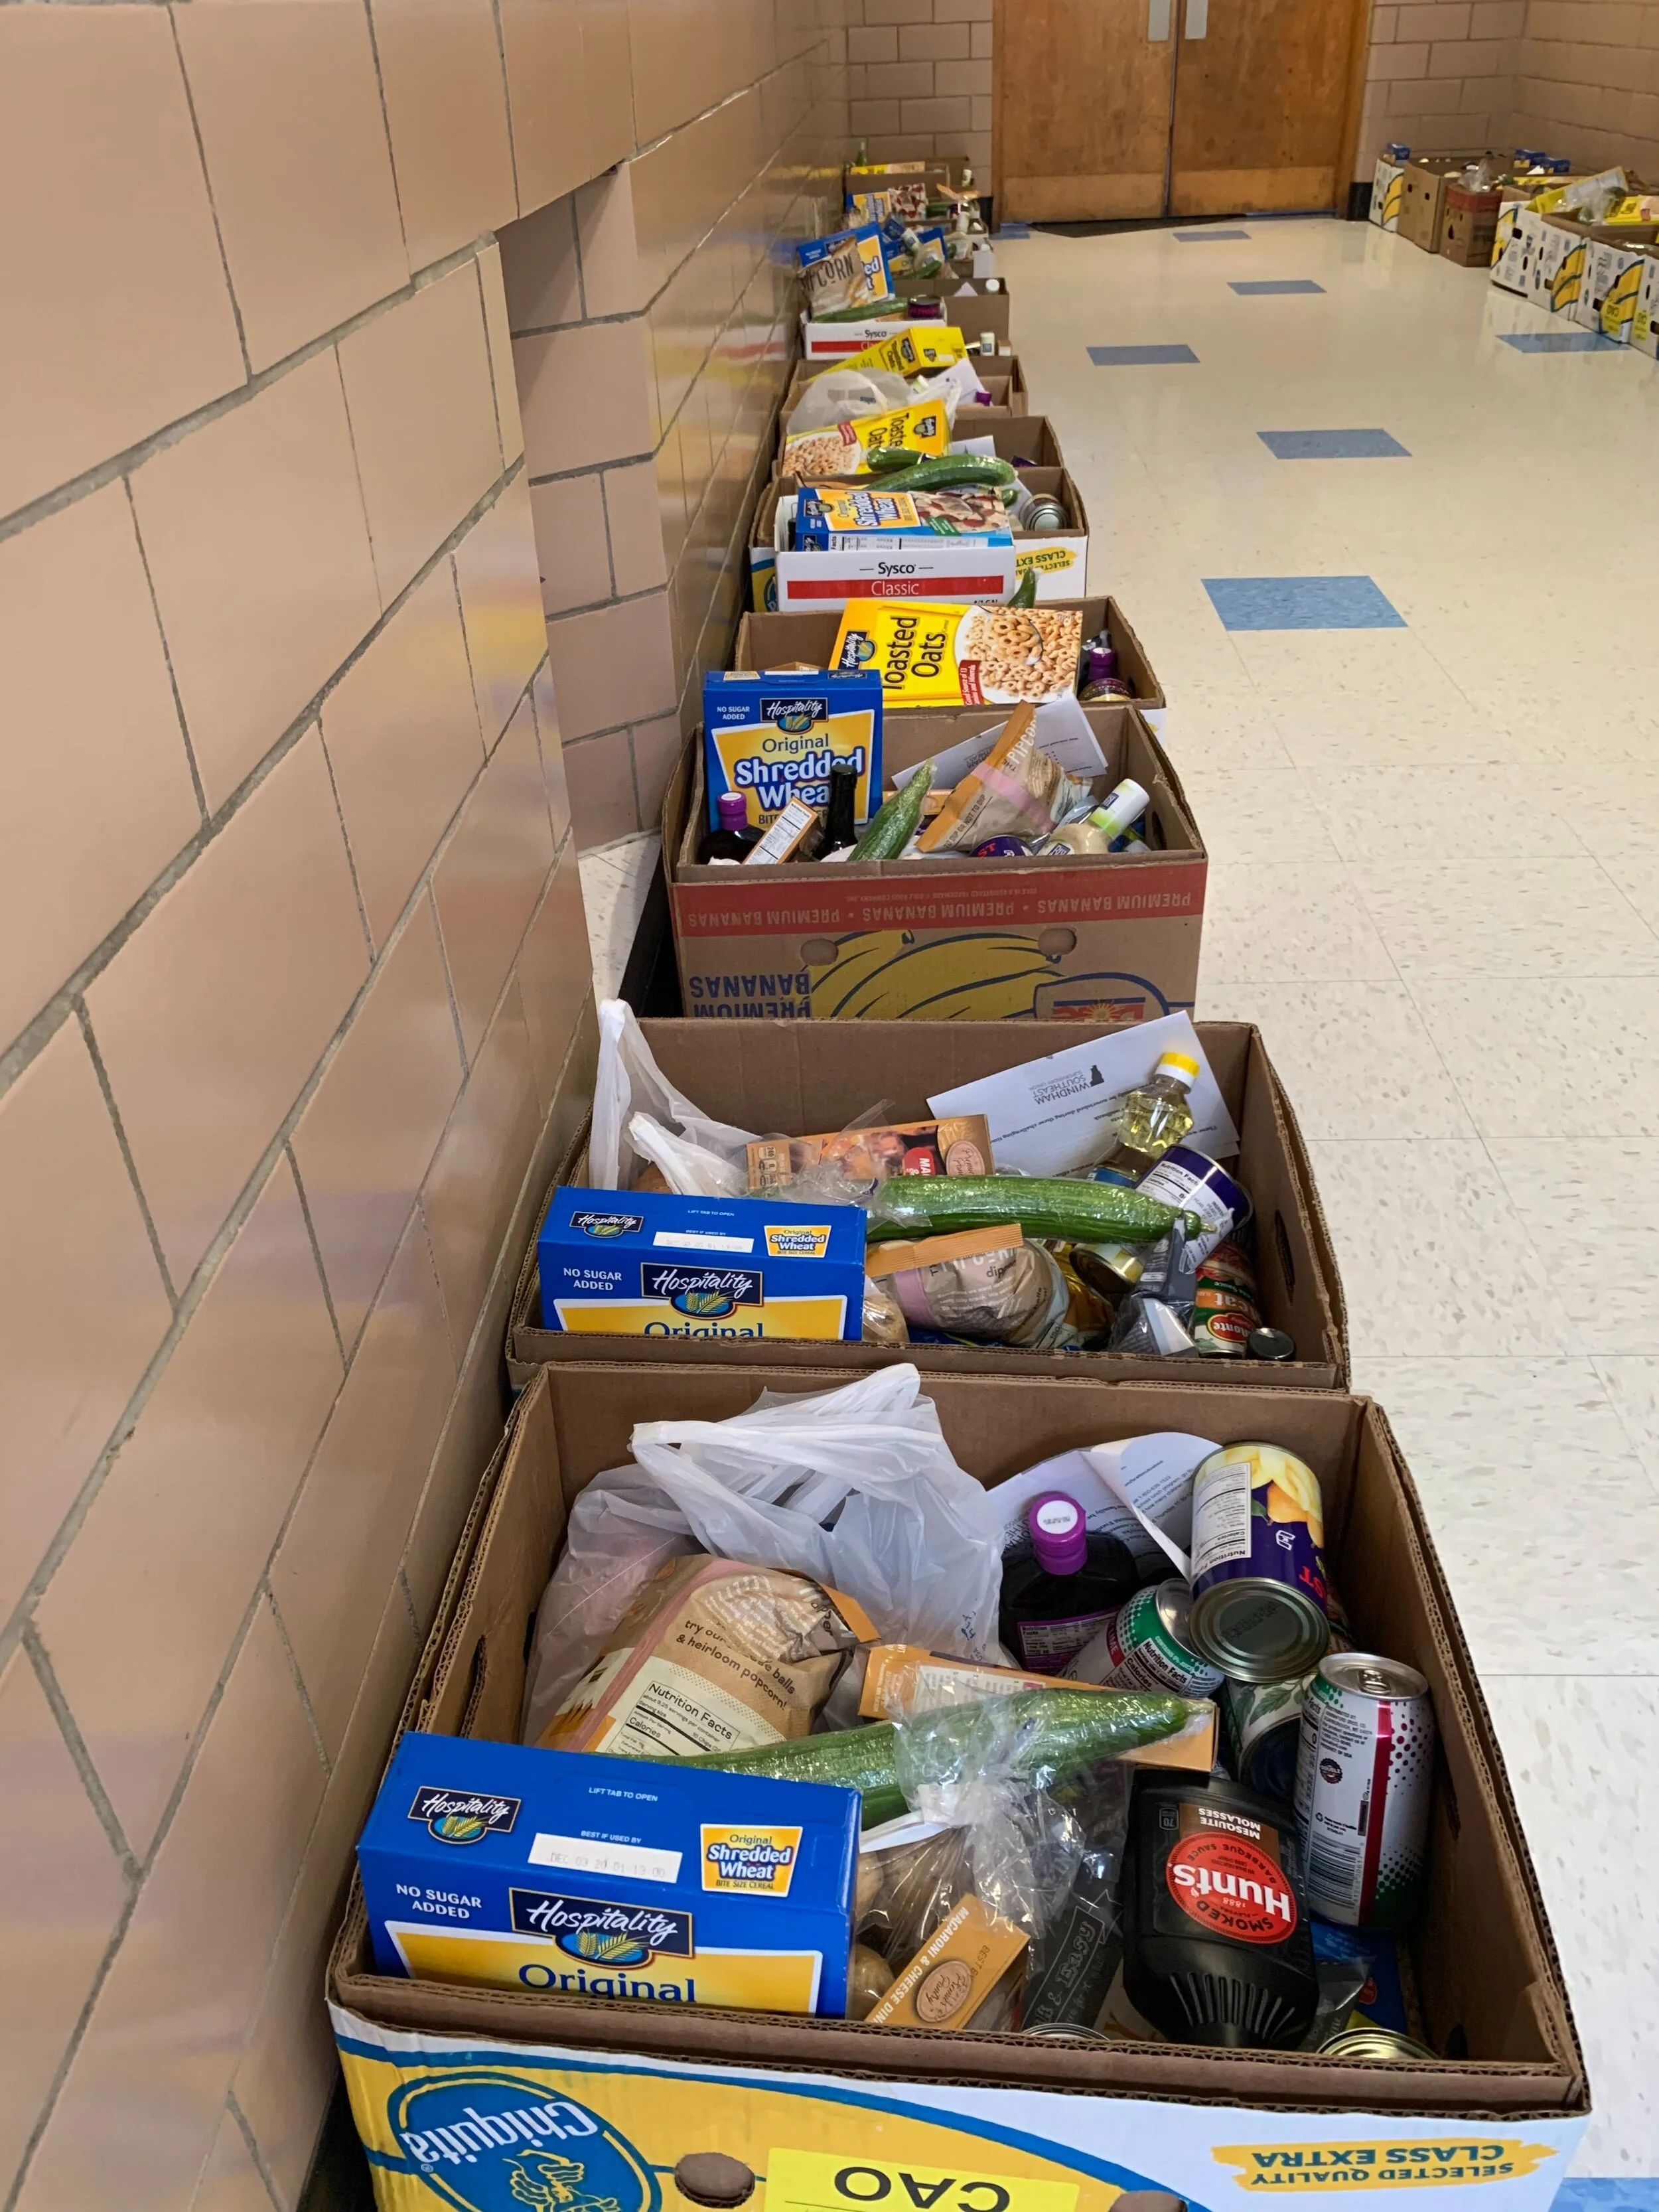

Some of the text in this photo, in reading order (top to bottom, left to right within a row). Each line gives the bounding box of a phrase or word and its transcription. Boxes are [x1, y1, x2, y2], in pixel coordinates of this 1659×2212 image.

[889, 412, 910, 448] Toaste
[852, 491, 878, 526] Shredded
[875, 497, 900, 521] Wheat
[877, 562, 914, 577] Sysco
[1016, 550, 1066, 567] CLASS EXT
[871, 581, 920, 595] Classic
[841, 633, 864, 667] Hospitality
[910, 633, 946, 678] Oats
[968, 664, 976, 683] Minerals
[766, 700, 823, 719] Hospitality
[762, 734, 829, 753] Original
[1003, 759, 1017, 773] THE
[758, 781, 831, 809] Whea
[964, 812, 974, 826] NOT
[972, 803, 979, 815] TO
[977, 794, 986, 807] DIP
[688, 893, 1190, 926] PREMIUM BANANAS PREMIUM BANANAS PREMIUM BANANAS
[689, 973, 810, 997] BANANAS
[1033, 1074, 1086, 1098] SOUTHEAST
[1034, 1083, 1090, 1105] WINDHAM
[1054, 1110, 1076, 1120] during
[1076, 1099, 1108, 1113] nourished
[1003, 1123, 1037, 1139] challenging
[1038, 1116, 1054, 1126] these
[577, 1215, 636, 1229] Hospitality
[770, 1234, 826, 1243] Shredded
[563, 1267, 622, 1282] NO SUGAR
[573, 1278, 614, 1291] ADDED
[652, 1269, 753, 1298] Hospitality
[1217, 1530, 1246, 1541] Calories
[1208, 1550, 1246, 1567] Nutrition
[685, 1619, 796, 1695] try our balls
[1143, 1641, 1188, 1684] Nutrition Facts
[676, 1634, 788, 1711] & heirloom popcorn!
[1127, 1659, 1153, 1688] Calories
[634, 1710, 648, 1720] Amount
[643, 1694, 657, 1703] about
[668, 1706, 689, 1722] servings
[687, 1720, 697, 1728] per
[697, 1726, 721, 1743] container
[648, 1683, 733, 1739] Nutrition Facts
[630, 1717, 662, 1739] Calories
[638, 1700, 713, 1749] Serving size Chips
[1312, 1732, 1317, 1745] 0
[589, 1787, 606, 1795] LIFT
[606, 1789, 622, 1797] TAB
[635, 1792, 658, 1803] OPEN
[421, 1793, 511, 1824] Hospitality
[1198, 1808, 1261, 1832] MOLASSES
[581, 1830, 601, 1838] BEST
[609, 1834, 630, 1843] USED
[729, 1834, 772, 1846] Original
[1200, 1817, 1261, 1840] MESQUITE
[550, 1852, 569, 1865] DEC
[707, 1844, 792, 1865] Shredded
[1189, 1843, 1277, 1884] BARBEQUE SAUCE
[720, 1863, 774, 1880] Wheat
[396, 1883, 482, 1909] NO SUGAR
[715, 1880, 731, 1888] BITE
[748, 1881, 774, 1890] CEREAL
[1173, 1864, 1291, 1923] Hunt's
[411, 1900, 470, 1919] ADDED
[1222, 1897, 1246, 1908] 1888
[526, 1899, 679, 1946] Hospitality
[1196, 1899, 1274, 1932] SMOKED
[890, 1906, 970, 2006] MACARONI & CHEESE
[977, 1945, 991, 1970] BEST
[518, 1964, 697, 2003] Original
[399, 2101, 599, 2166] Chiquita
[1252, 2145, 1504, 2168] CLASS EXTRA
[1250, 2162, 1514, 2185] SELECTED QUALITY
[833, 2166, 1011, 2212] CAO
